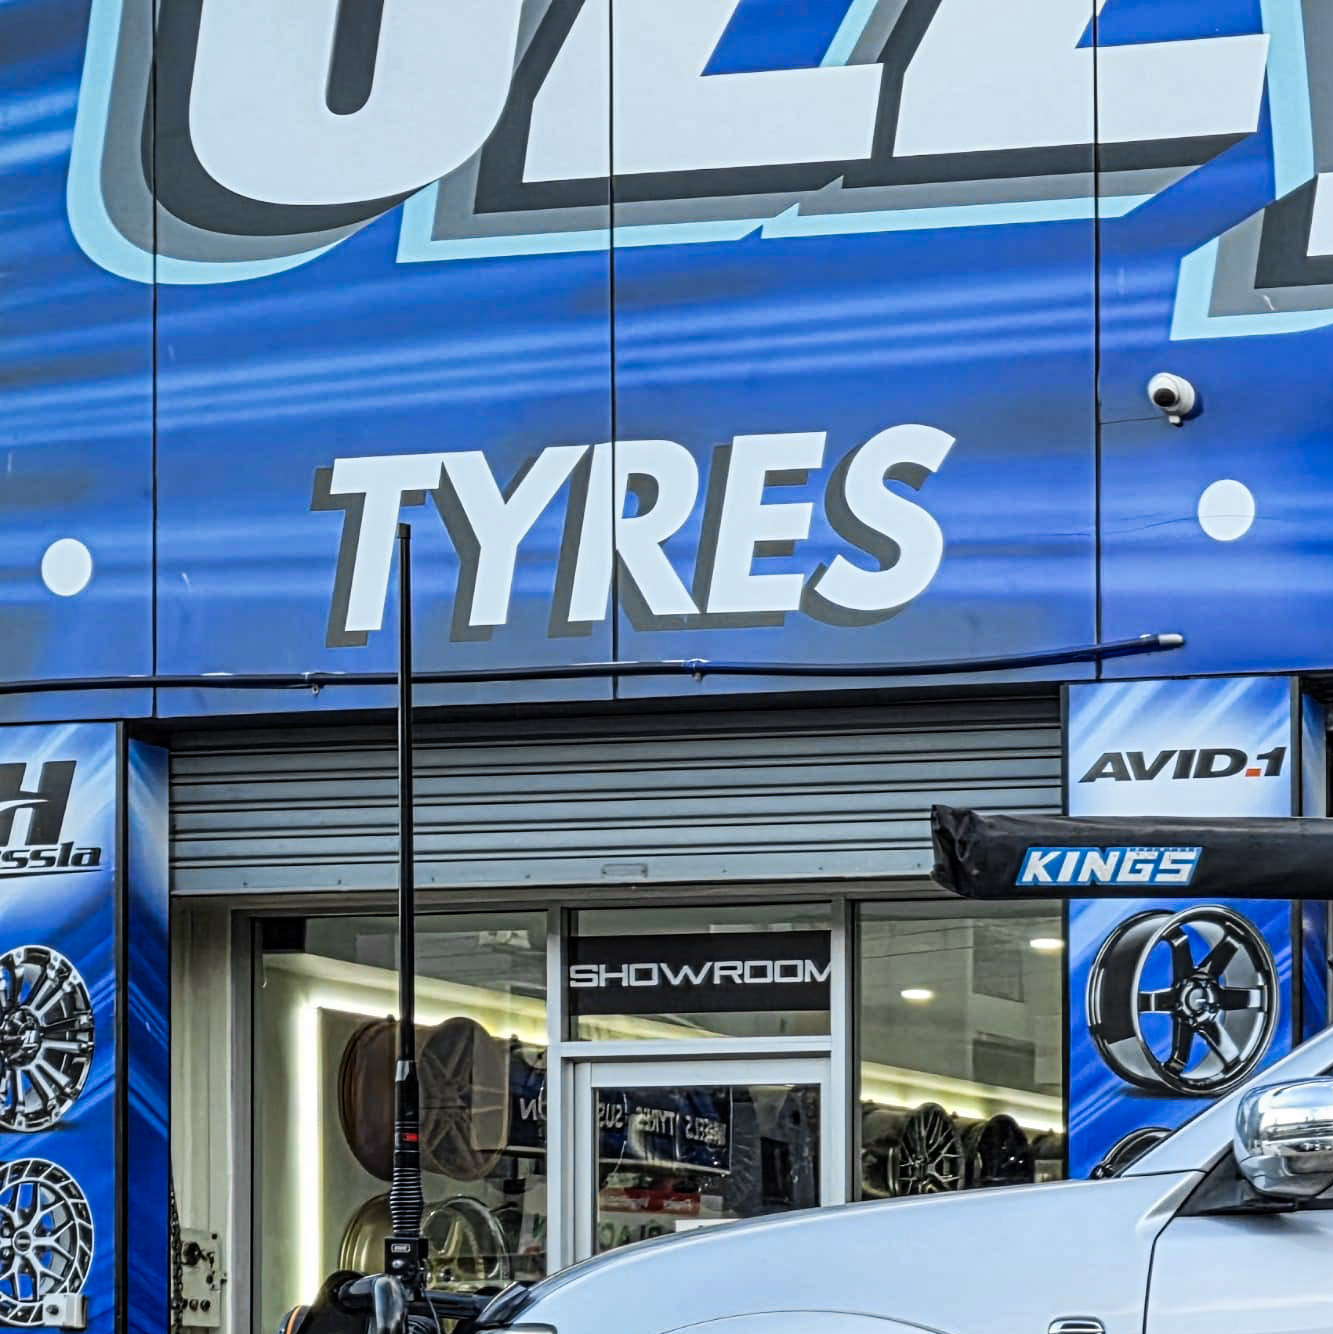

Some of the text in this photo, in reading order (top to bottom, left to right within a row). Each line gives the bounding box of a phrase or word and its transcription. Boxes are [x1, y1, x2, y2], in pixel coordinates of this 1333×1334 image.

[330, 424, 956, 632] TYRES
[1078, 746, 1287, 783] AVID.1
[1021, 850, 1196, 883] KINGS
[570, 960, 832, 987] SHOWROOM
